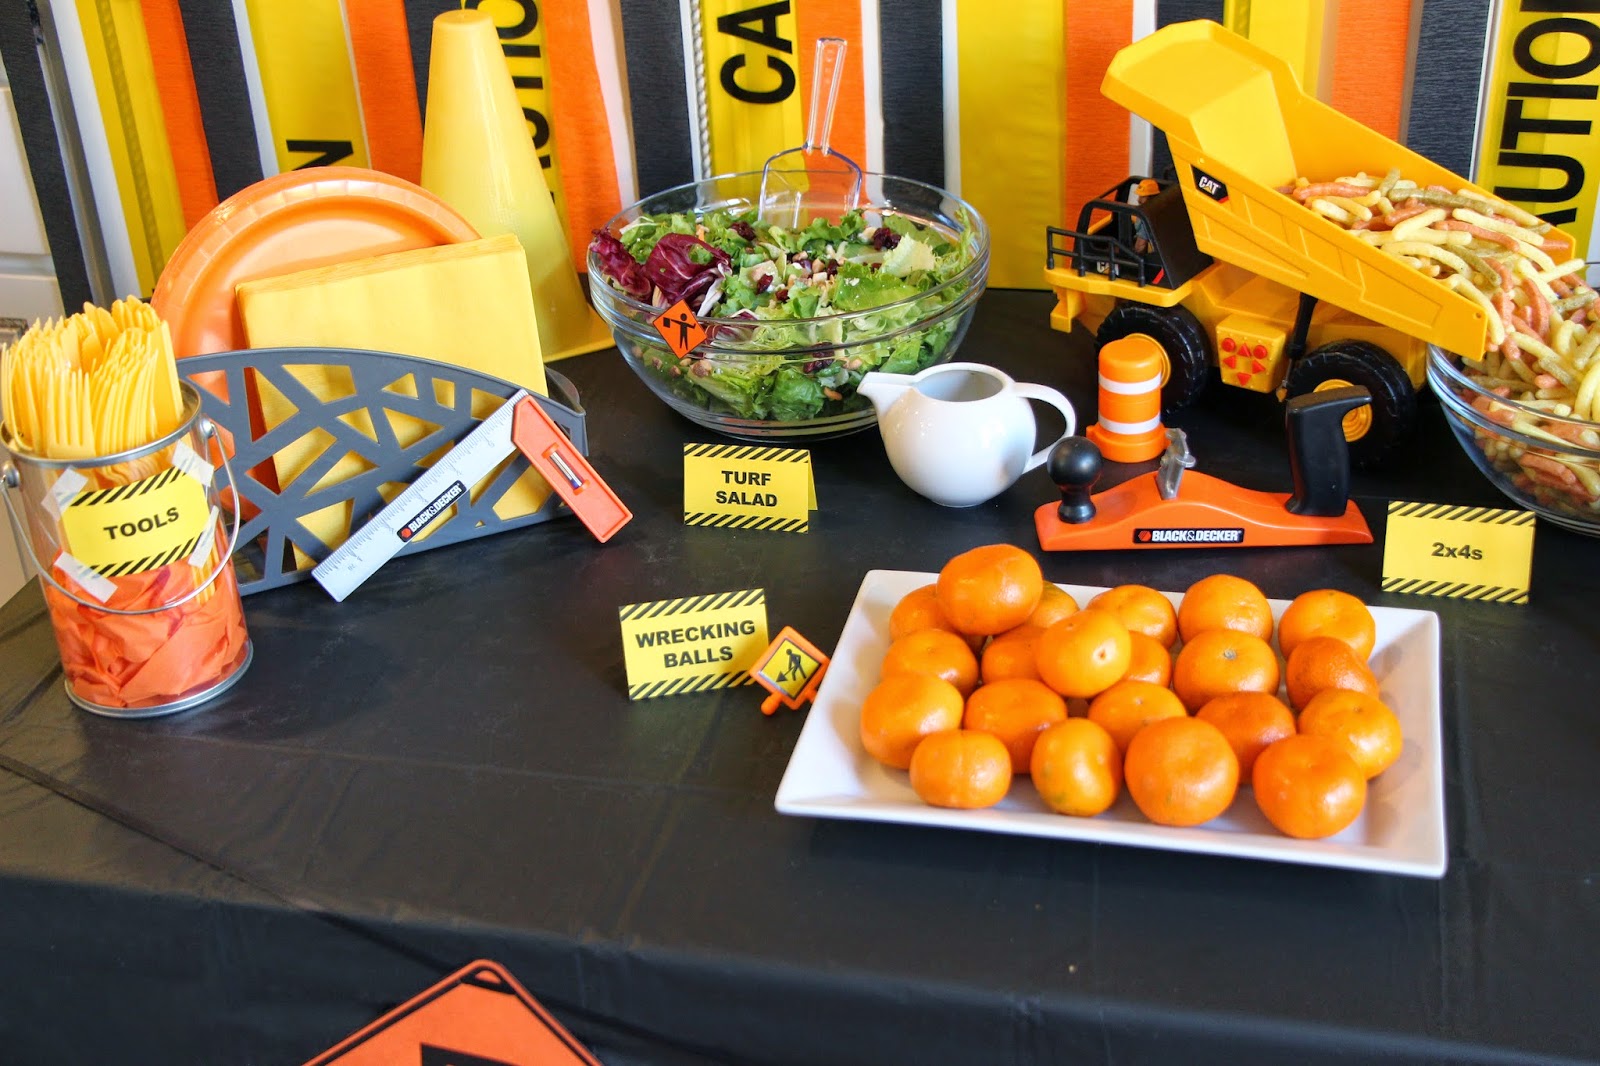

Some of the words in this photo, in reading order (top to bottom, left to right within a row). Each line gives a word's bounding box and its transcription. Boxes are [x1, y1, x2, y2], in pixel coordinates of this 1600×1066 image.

[1494, 0, 1600, 228] UTIO
[1199, 175, 1221, 195] CAT
[721, 470, 772, 486] TURF
[408, 483, 463, 533] BLACK&DECKER
[716, 490, 778, 507] SALAD
[103, 507, 180, 540] TOOLS
[1151, 530, 1240, 542] BLACK&DECKER
[1431, 541, 1483, 560] 2x4s
[635, 620, 756, 648] WRECKING
[663, 646, 733, 668] BALLS
